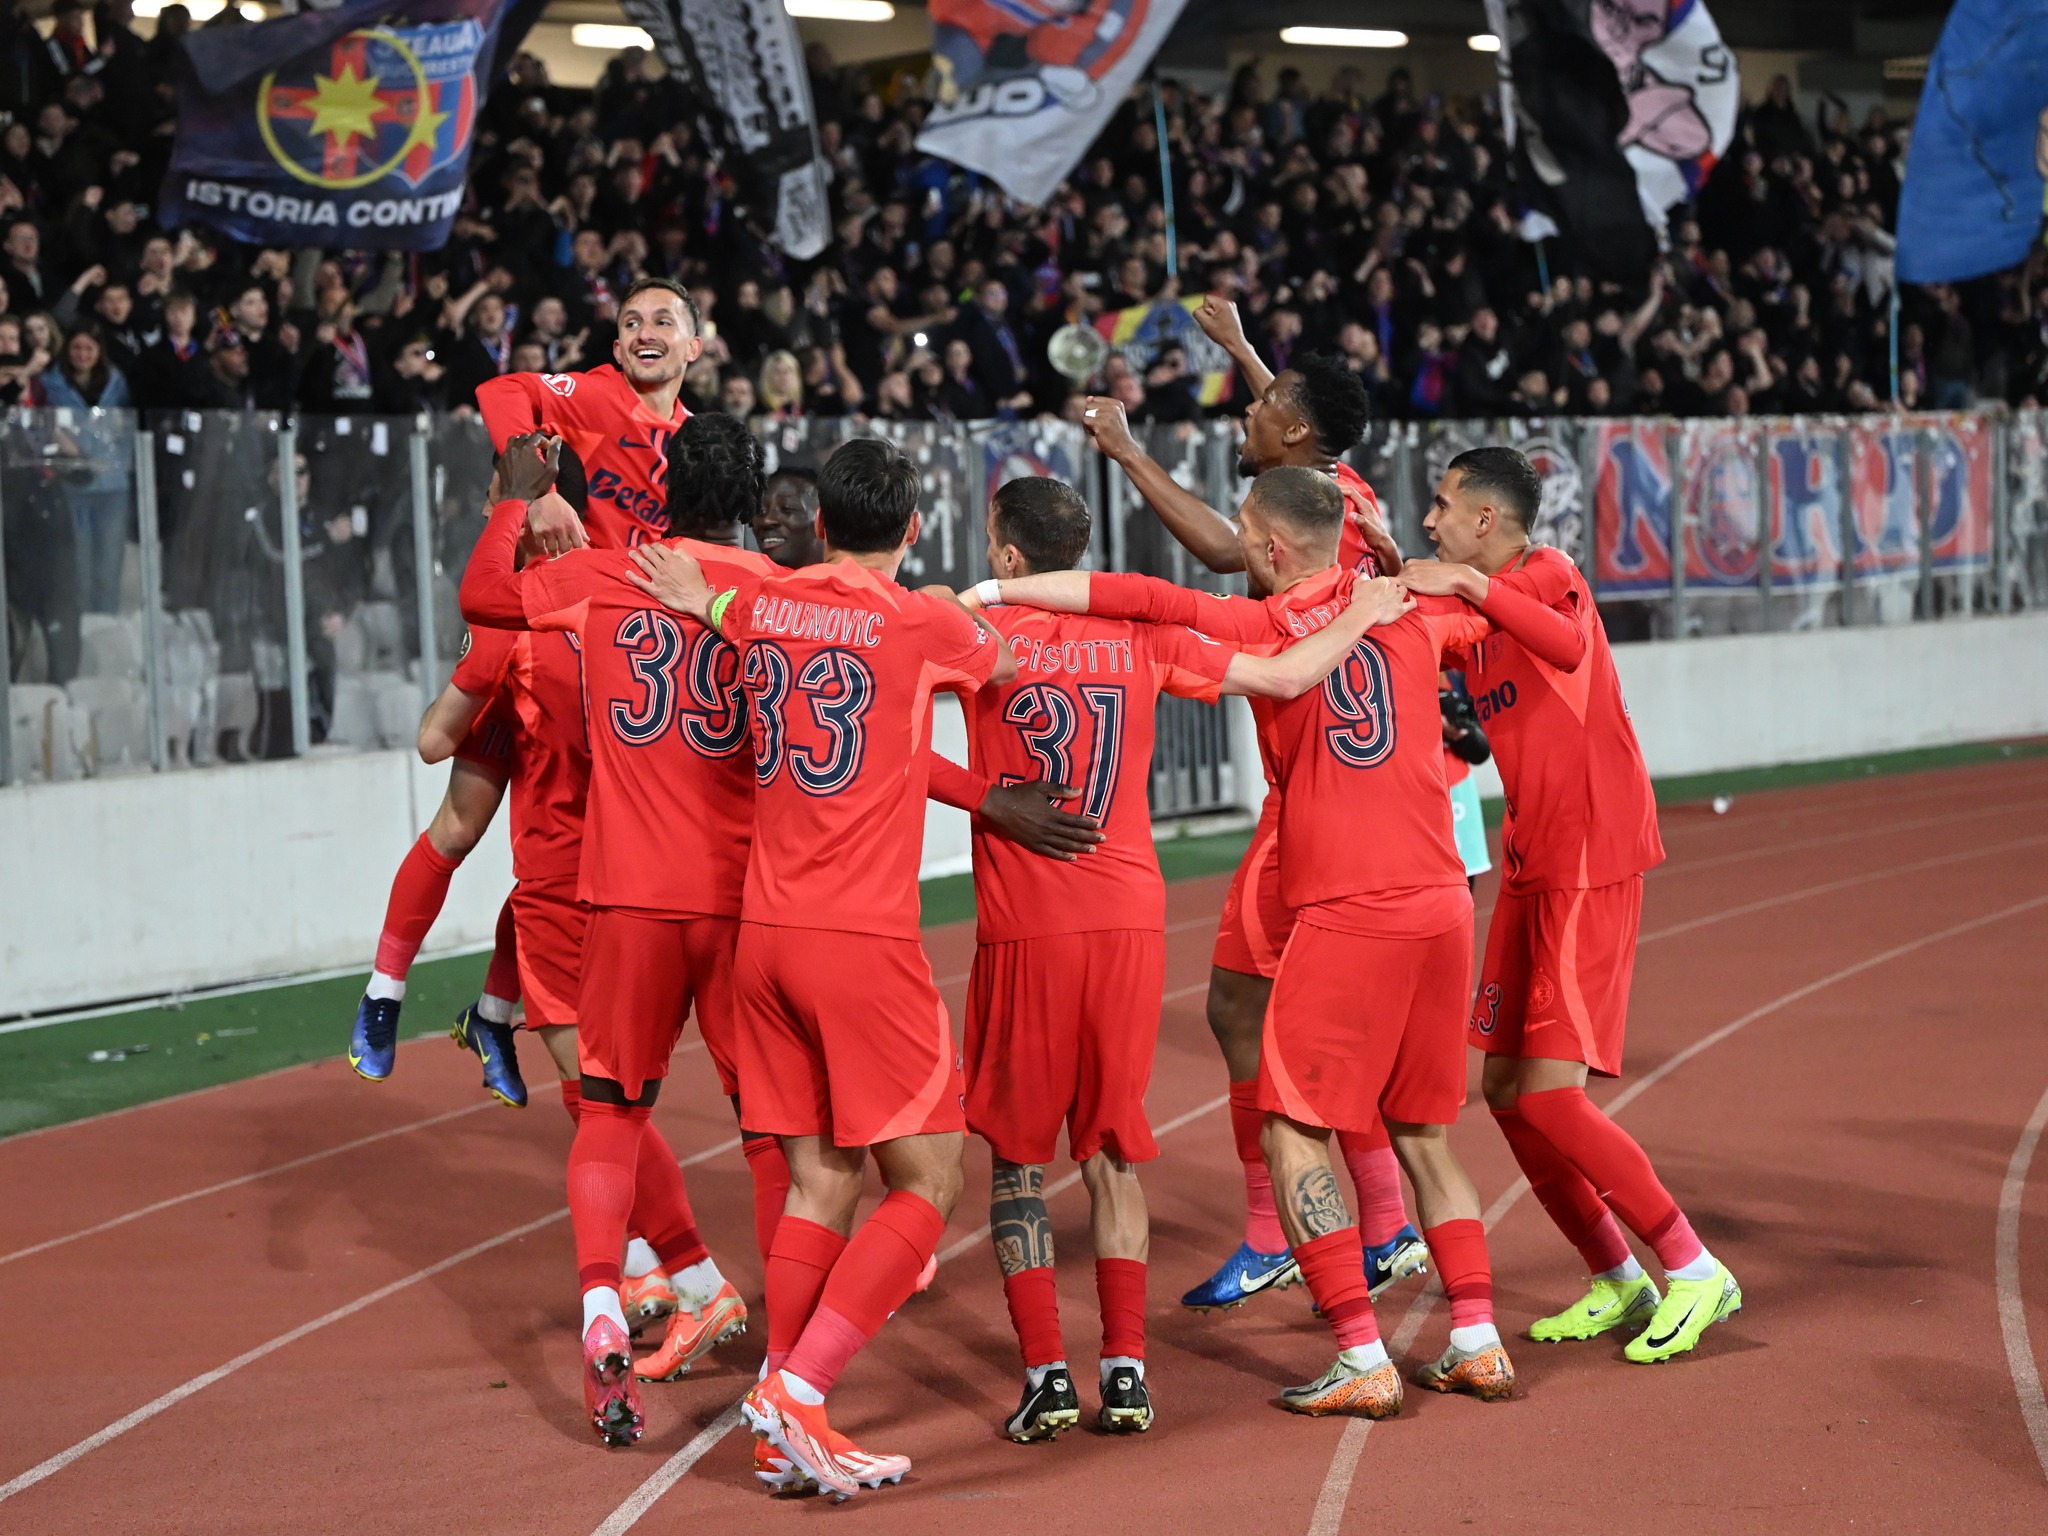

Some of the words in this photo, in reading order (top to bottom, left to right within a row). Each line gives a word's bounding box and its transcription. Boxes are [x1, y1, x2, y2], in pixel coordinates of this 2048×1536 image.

[186, 178, 339, 227] ISTORIA
[588, 467, 669, 528] Betan
[751, 595, 885, 648] RADUNOVIC
[610, 609, 751, 760] 39
[1008, 634, 1134, 674] CISOTTI
[743, 640, 876, 797] 33
[1322, 635, 1397, 769] 9
[1000, 683, 1126, 828] 31
[1469, 979, 1503, 1036] 3
